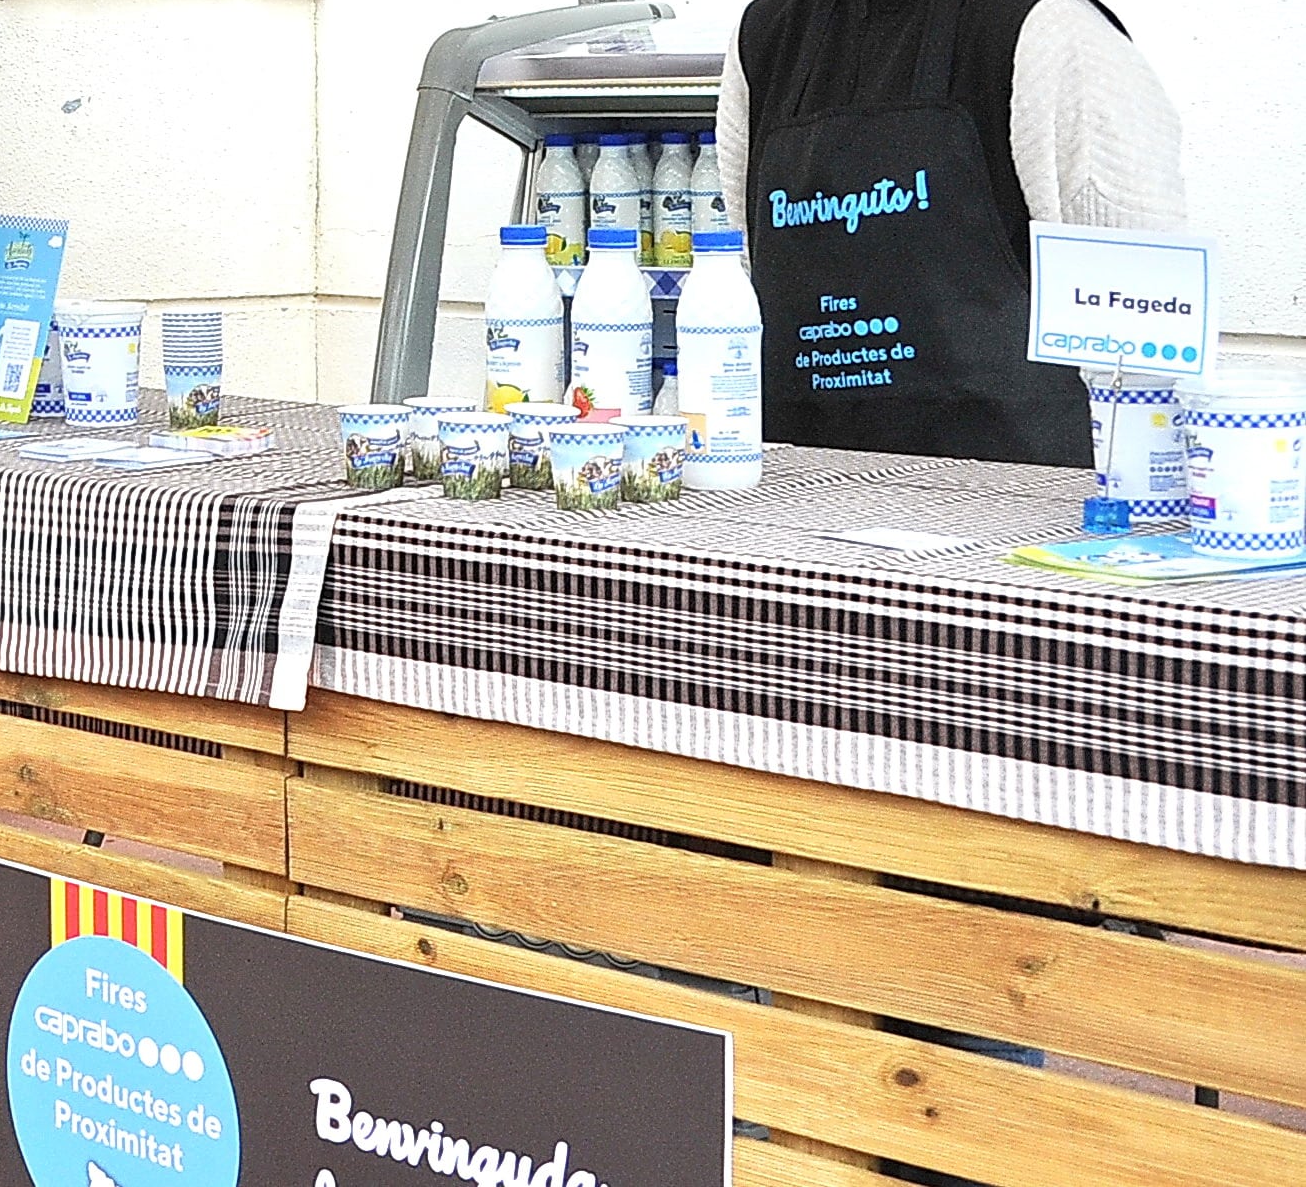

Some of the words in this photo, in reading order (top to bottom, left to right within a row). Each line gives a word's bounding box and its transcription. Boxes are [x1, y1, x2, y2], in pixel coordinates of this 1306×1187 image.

[820, 295, 857, 313] Fires
[1075, 287, 1101, 306] La
[1108, 290, 1192, 315] Fageda
[799, 321, 852, 342] caprabo
[1042, 332, 1136, 355] caprabo
[795, 353, 810, 369] de
[811, 346, 888, 367] Productes
[890, 342, 915, 360] de
[812, 368, 892, 390] Proximitat
[85, 967, 148, 1014] Fires
[34, 1006, 136, 1059] caprabo
[20, 1048, 51, 1081] de
[55, 1057, 183, 1128] Productes
[186, 1103, 223, 1139] de
[54, 1099, 185, 1173] Proximitat
